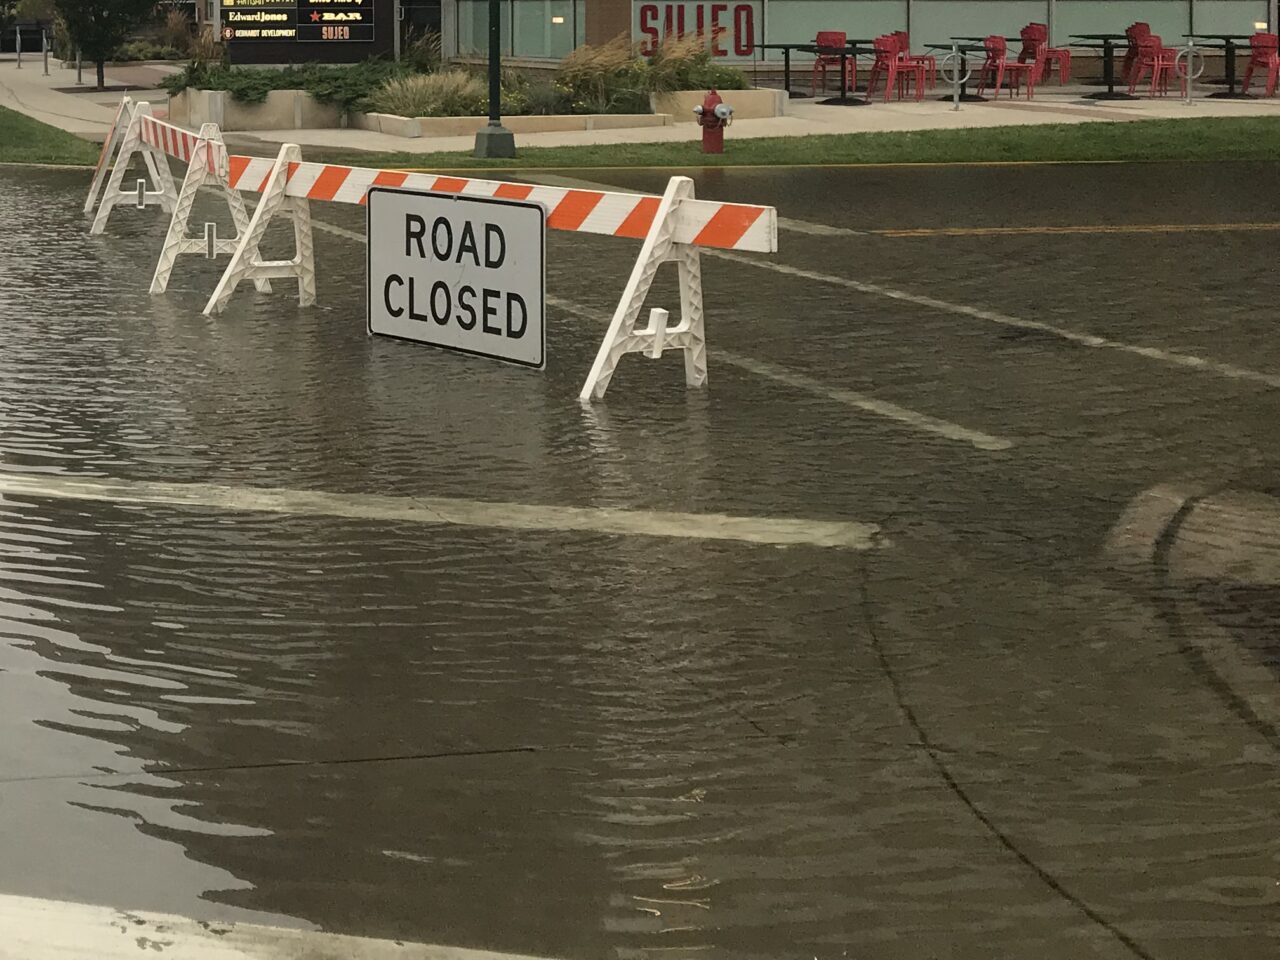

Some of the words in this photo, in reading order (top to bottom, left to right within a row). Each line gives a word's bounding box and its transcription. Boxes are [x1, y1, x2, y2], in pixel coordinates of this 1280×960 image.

[228, 11, 261, 21] Edward
[260, 11, 288, 23] Jones
[261, 29, 296, 38] DEVELOPMENT
[321, 26, 350, 40] SUJEO
[405, 213, 506, 269] ROAD
[383, 273, 528, 340] CLOSED
